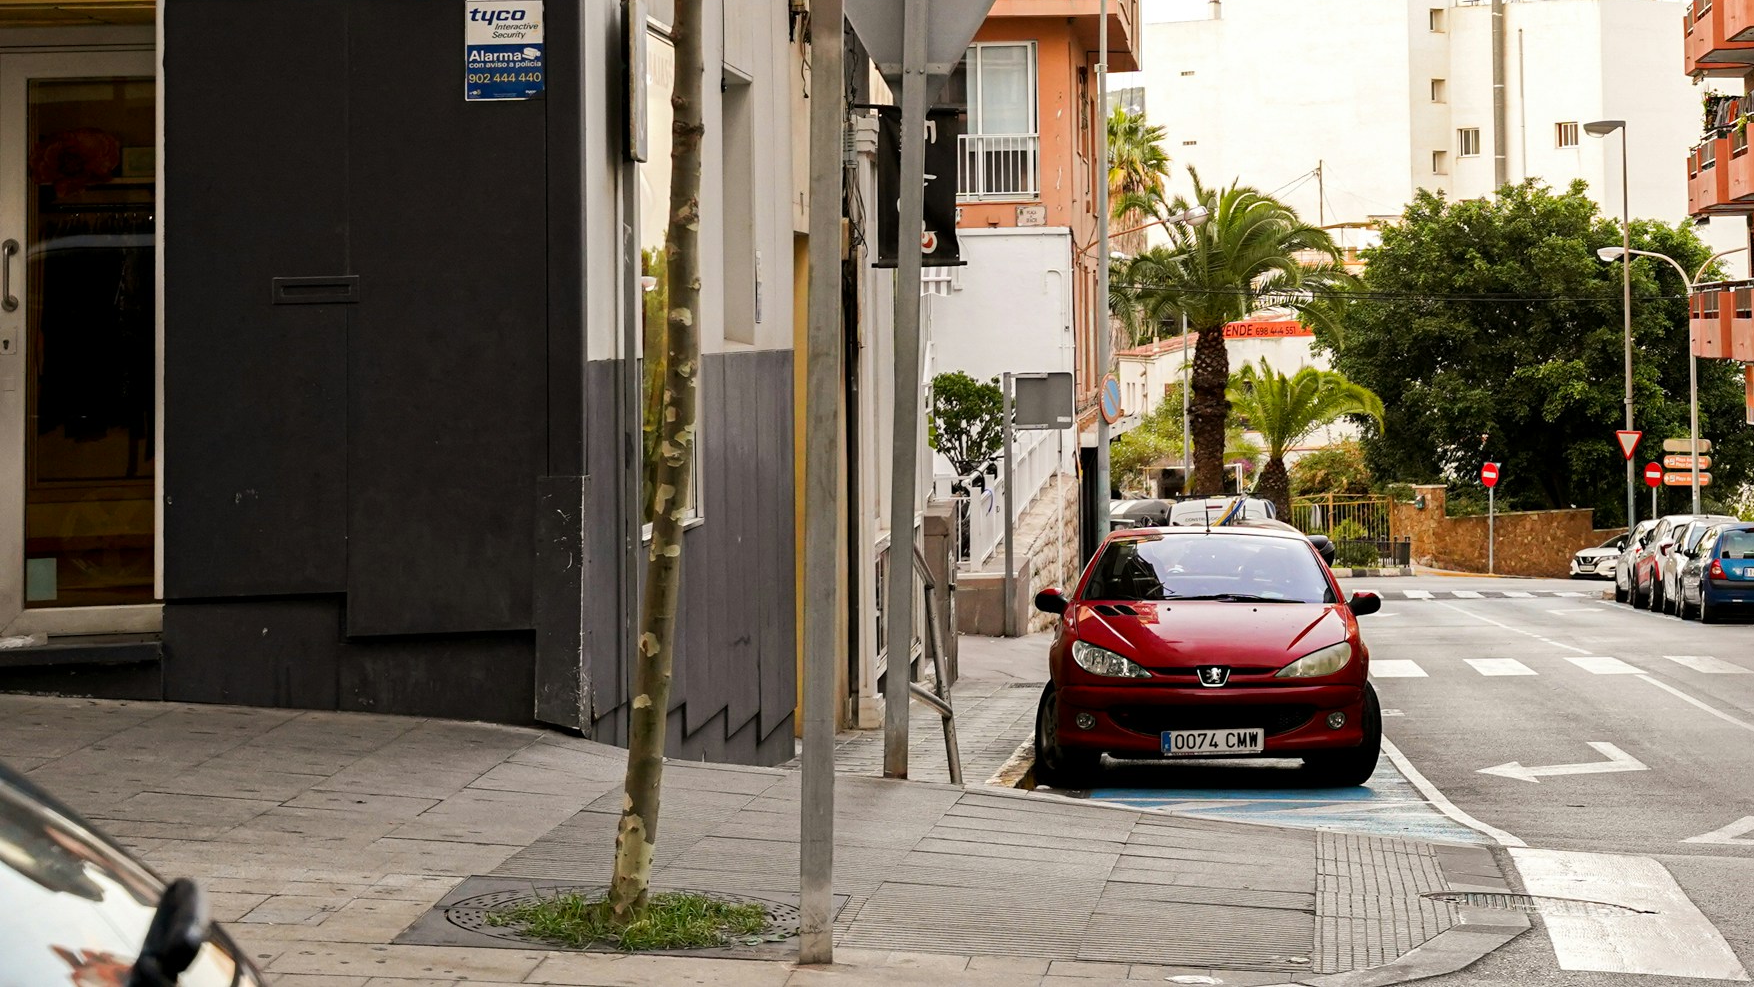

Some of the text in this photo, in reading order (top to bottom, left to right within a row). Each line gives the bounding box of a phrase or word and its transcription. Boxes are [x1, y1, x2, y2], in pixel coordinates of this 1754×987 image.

[469, 8, 526, 25] tyco
[494, 23, 538, 31] Interactive
[492, 31, 526, 39] Security
[469, 51, 521, 62] Alarma
[469, 72, 541, 83] 902 444 440
[1255, 327, 1268, 335] 698
[1285, 326, 1295, 334] 551
[1175, 732, 1258, 749] 0074 CMW
